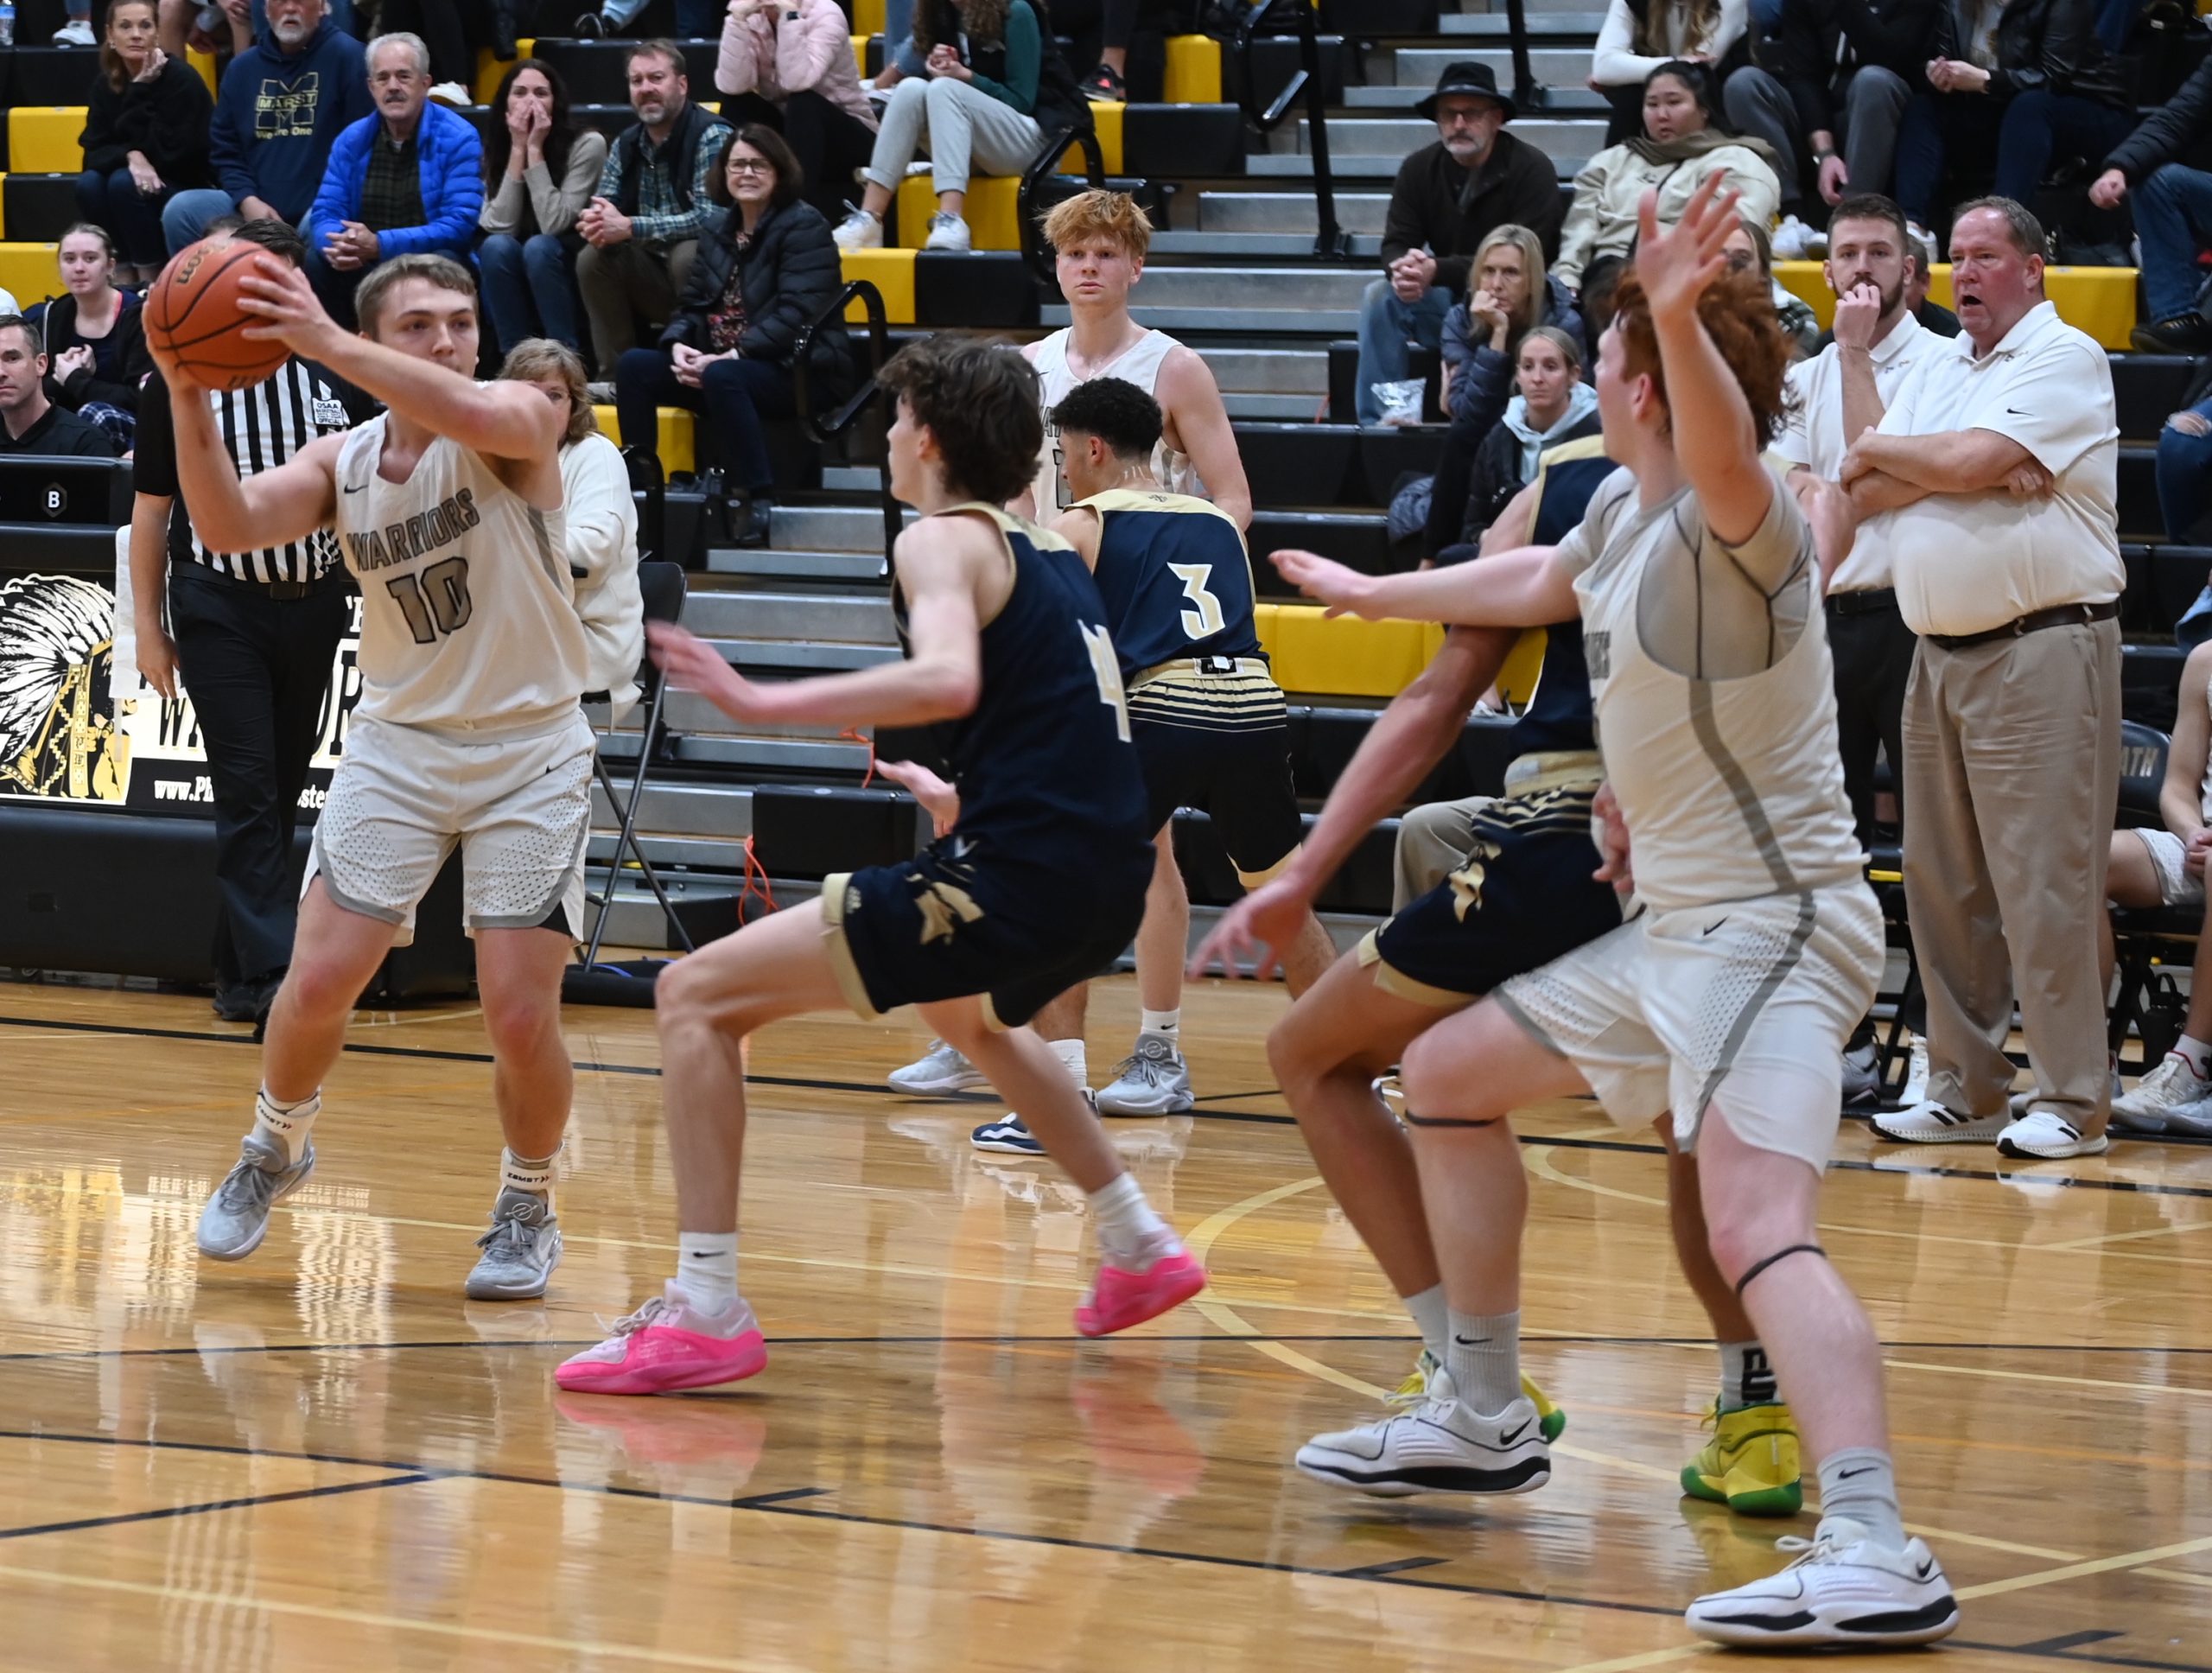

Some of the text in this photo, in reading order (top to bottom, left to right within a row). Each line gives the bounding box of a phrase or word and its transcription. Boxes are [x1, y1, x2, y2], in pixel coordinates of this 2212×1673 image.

[291, 126, 313, 136] One
[48, 491, 60, 508] B
[346, 487, 480, 572] WARRIORS
[385, 557, 473, 645] 10
[1166, 562, 1225, 640] 3
[1077, 619, 1132, 743] 4
